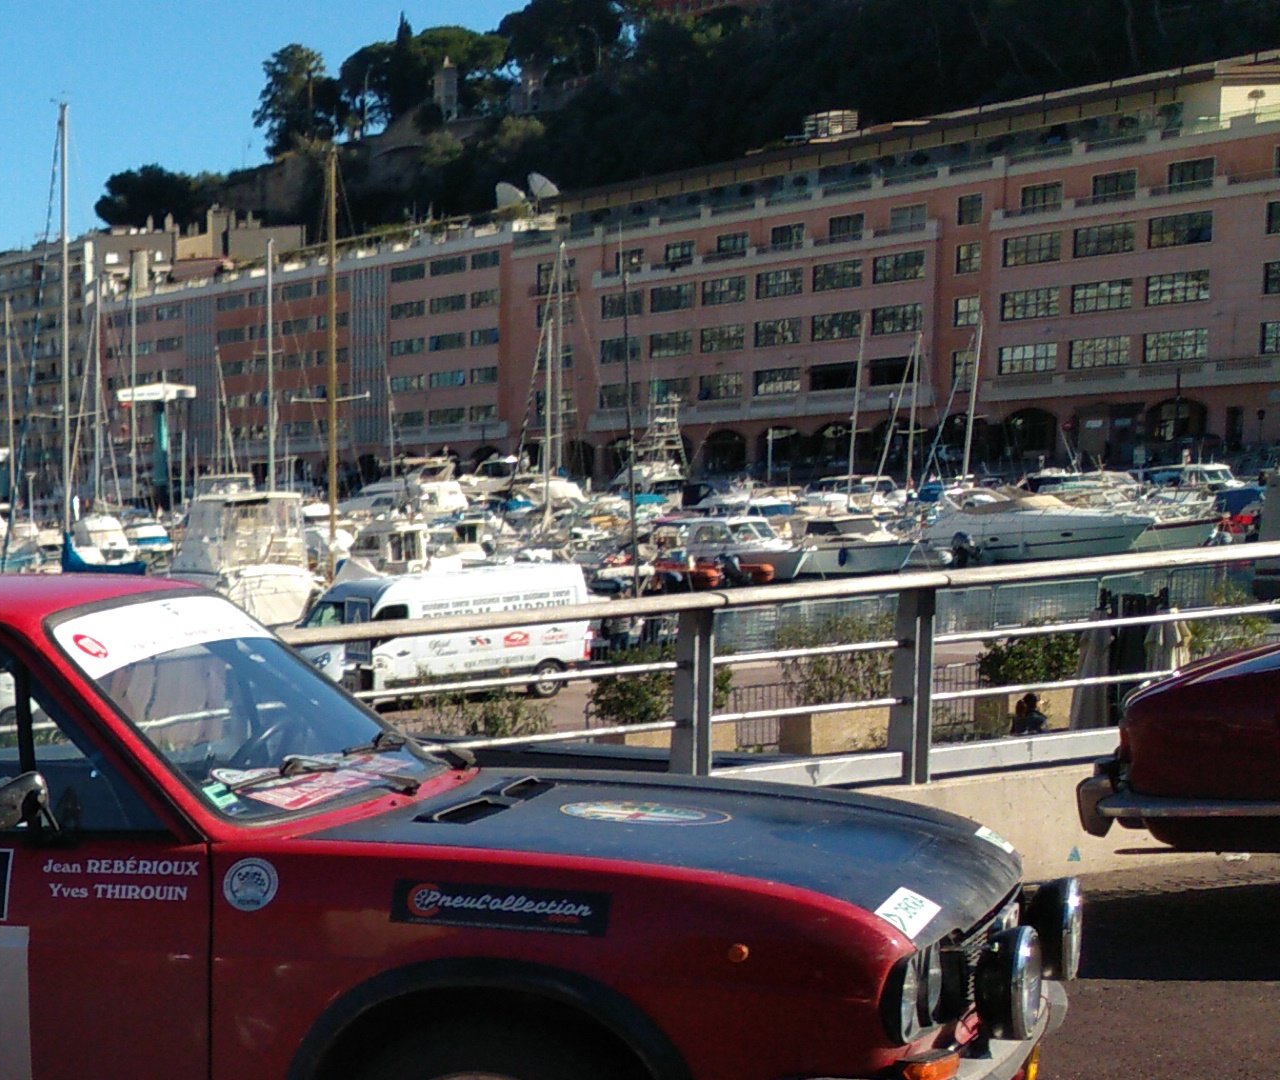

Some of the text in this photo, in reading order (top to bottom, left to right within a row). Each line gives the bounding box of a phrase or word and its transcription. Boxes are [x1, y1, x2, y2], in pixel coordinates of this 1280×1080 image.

[42, 856, 199, 876] Jean REBÉRIOUX
[48, 883, 189, 900] Yves THIROUIN
[425, 889, 592, 917] PneuCollection
